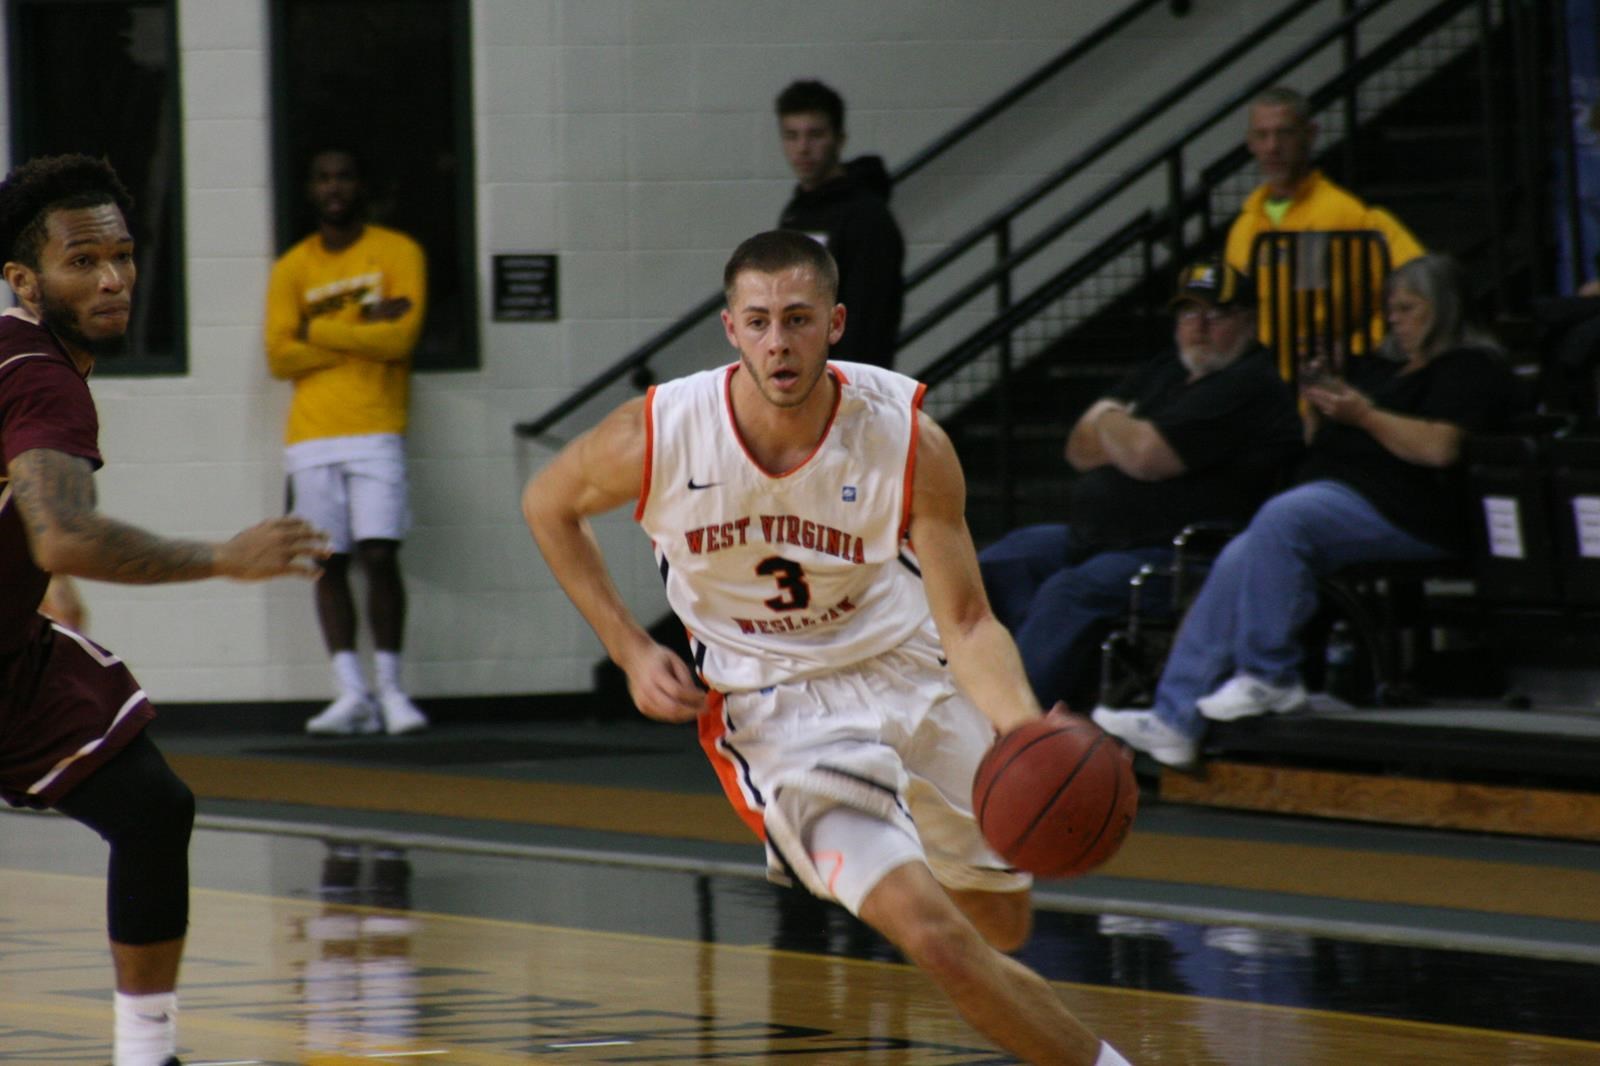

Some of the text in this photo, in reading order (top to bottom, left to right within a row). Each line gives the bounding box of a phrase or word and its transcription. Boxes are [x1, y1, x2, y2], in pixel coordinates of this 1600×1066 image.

[685, 515, 865, 564] WEST VIRGINIA
[755, 556, 811, 613] 3
